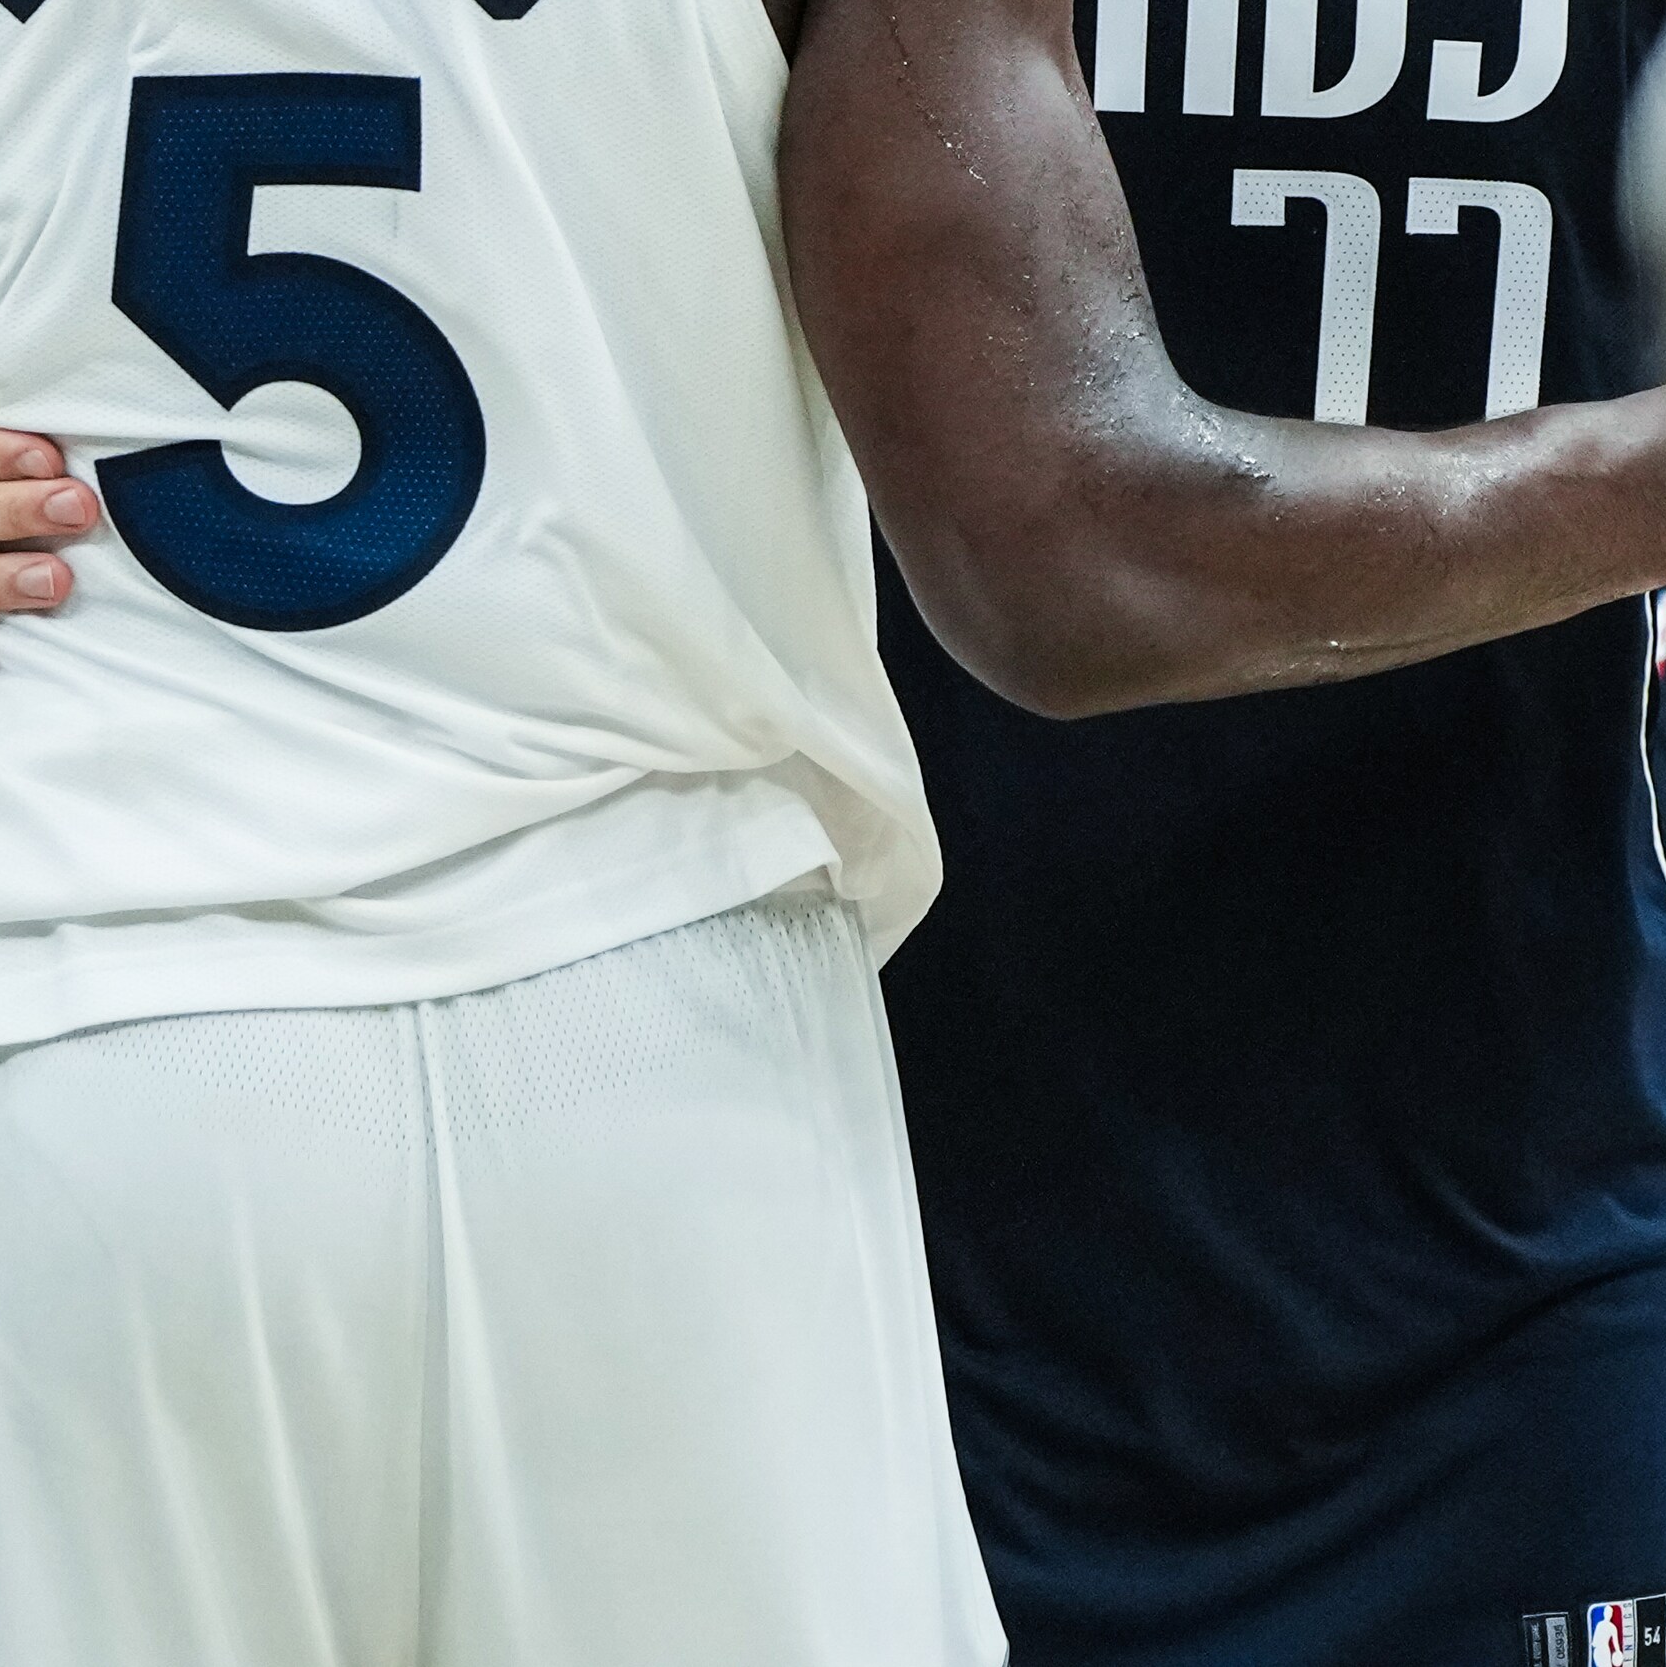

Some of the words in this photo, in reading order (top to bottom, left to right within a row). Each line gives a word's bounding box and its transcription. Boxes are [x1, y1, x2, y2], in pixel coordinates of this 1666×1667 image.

[95, 73, 487, 631] 5
[1231, 168, 1553, 425] 77
[1644, 1625, 1661, 1647] 54
